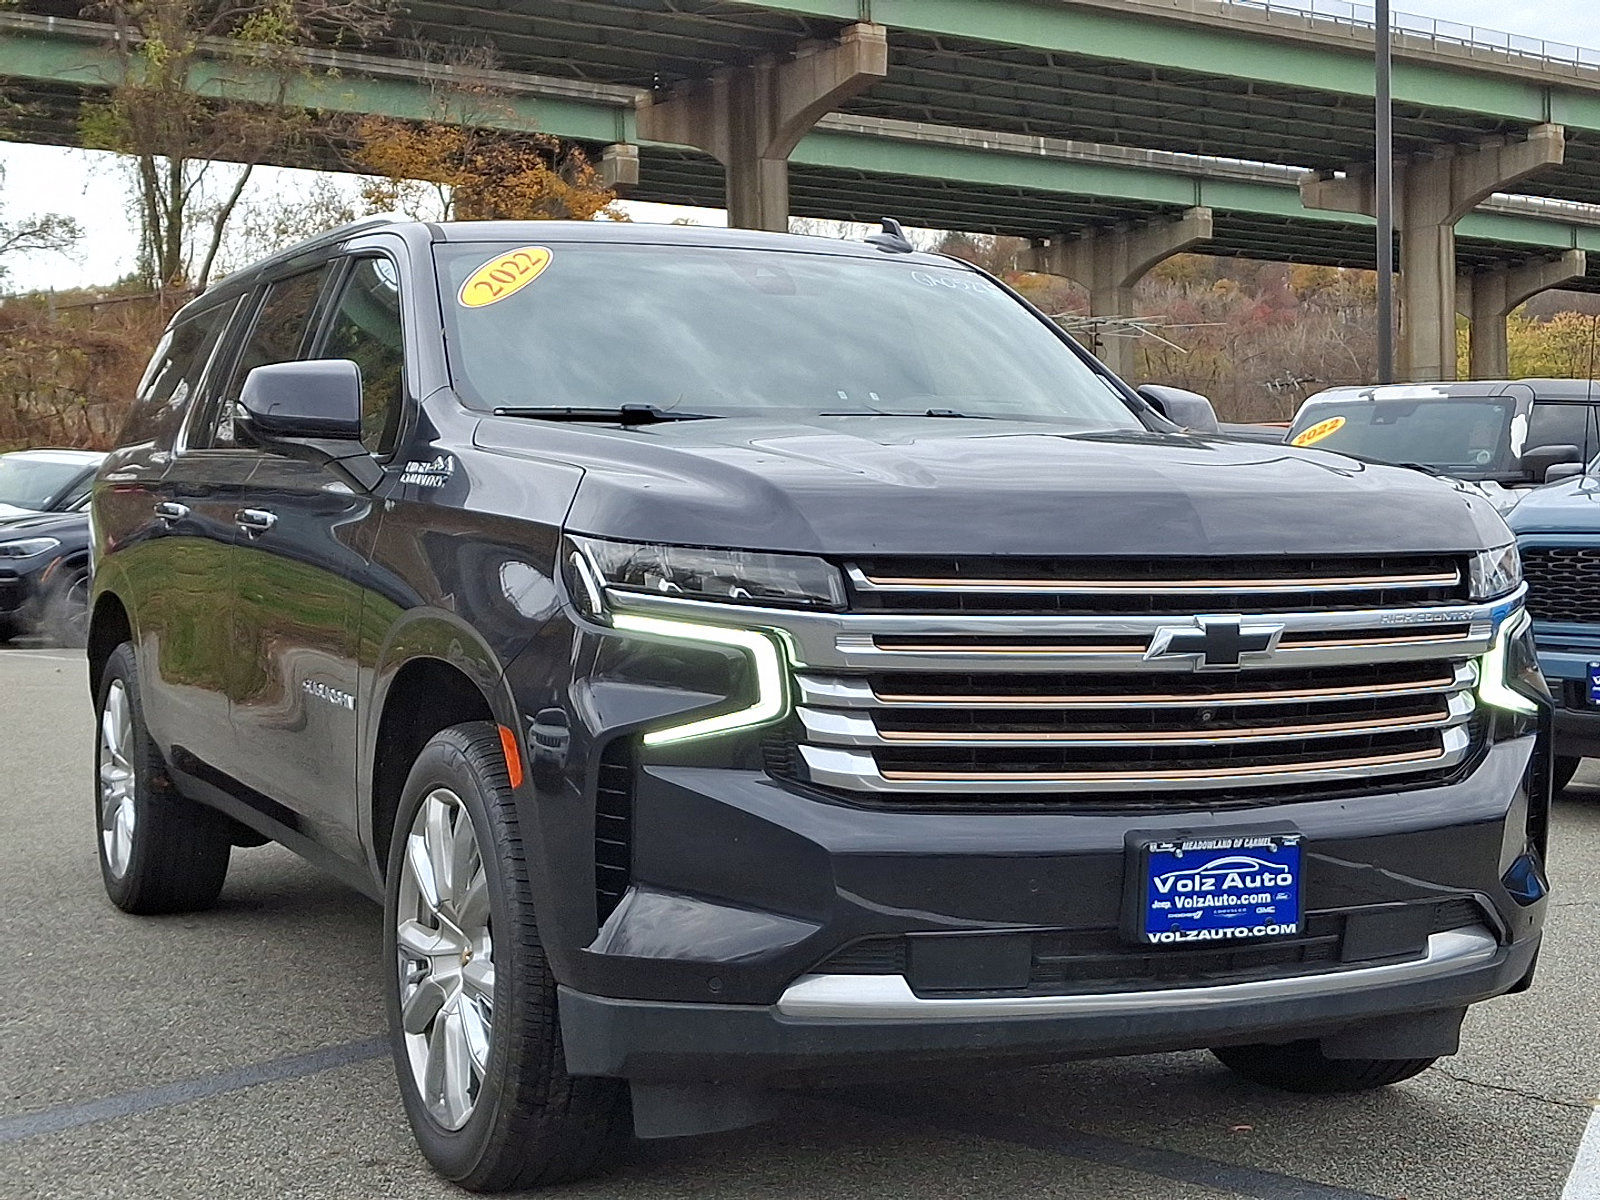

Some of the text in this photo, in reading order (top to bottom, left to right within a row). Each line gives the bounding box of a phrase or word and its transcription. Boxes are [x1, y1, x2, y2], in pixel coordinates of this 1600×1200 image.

[474, 253, 542, 297] 2022
[1298, 419, 1339, 444] 2022
[1182, 839, 1232, 850] MEADOWLAND
[1233, 838, 1243, 848] OF
[1153, 873, 1292, 893] Volz Auto
[1175, 893, 1271, 909] VolzAuto.com
[1256, 906, 1276, 914] GMC
[1147, 924, 1297, 943] VOLZAUTO.COM
